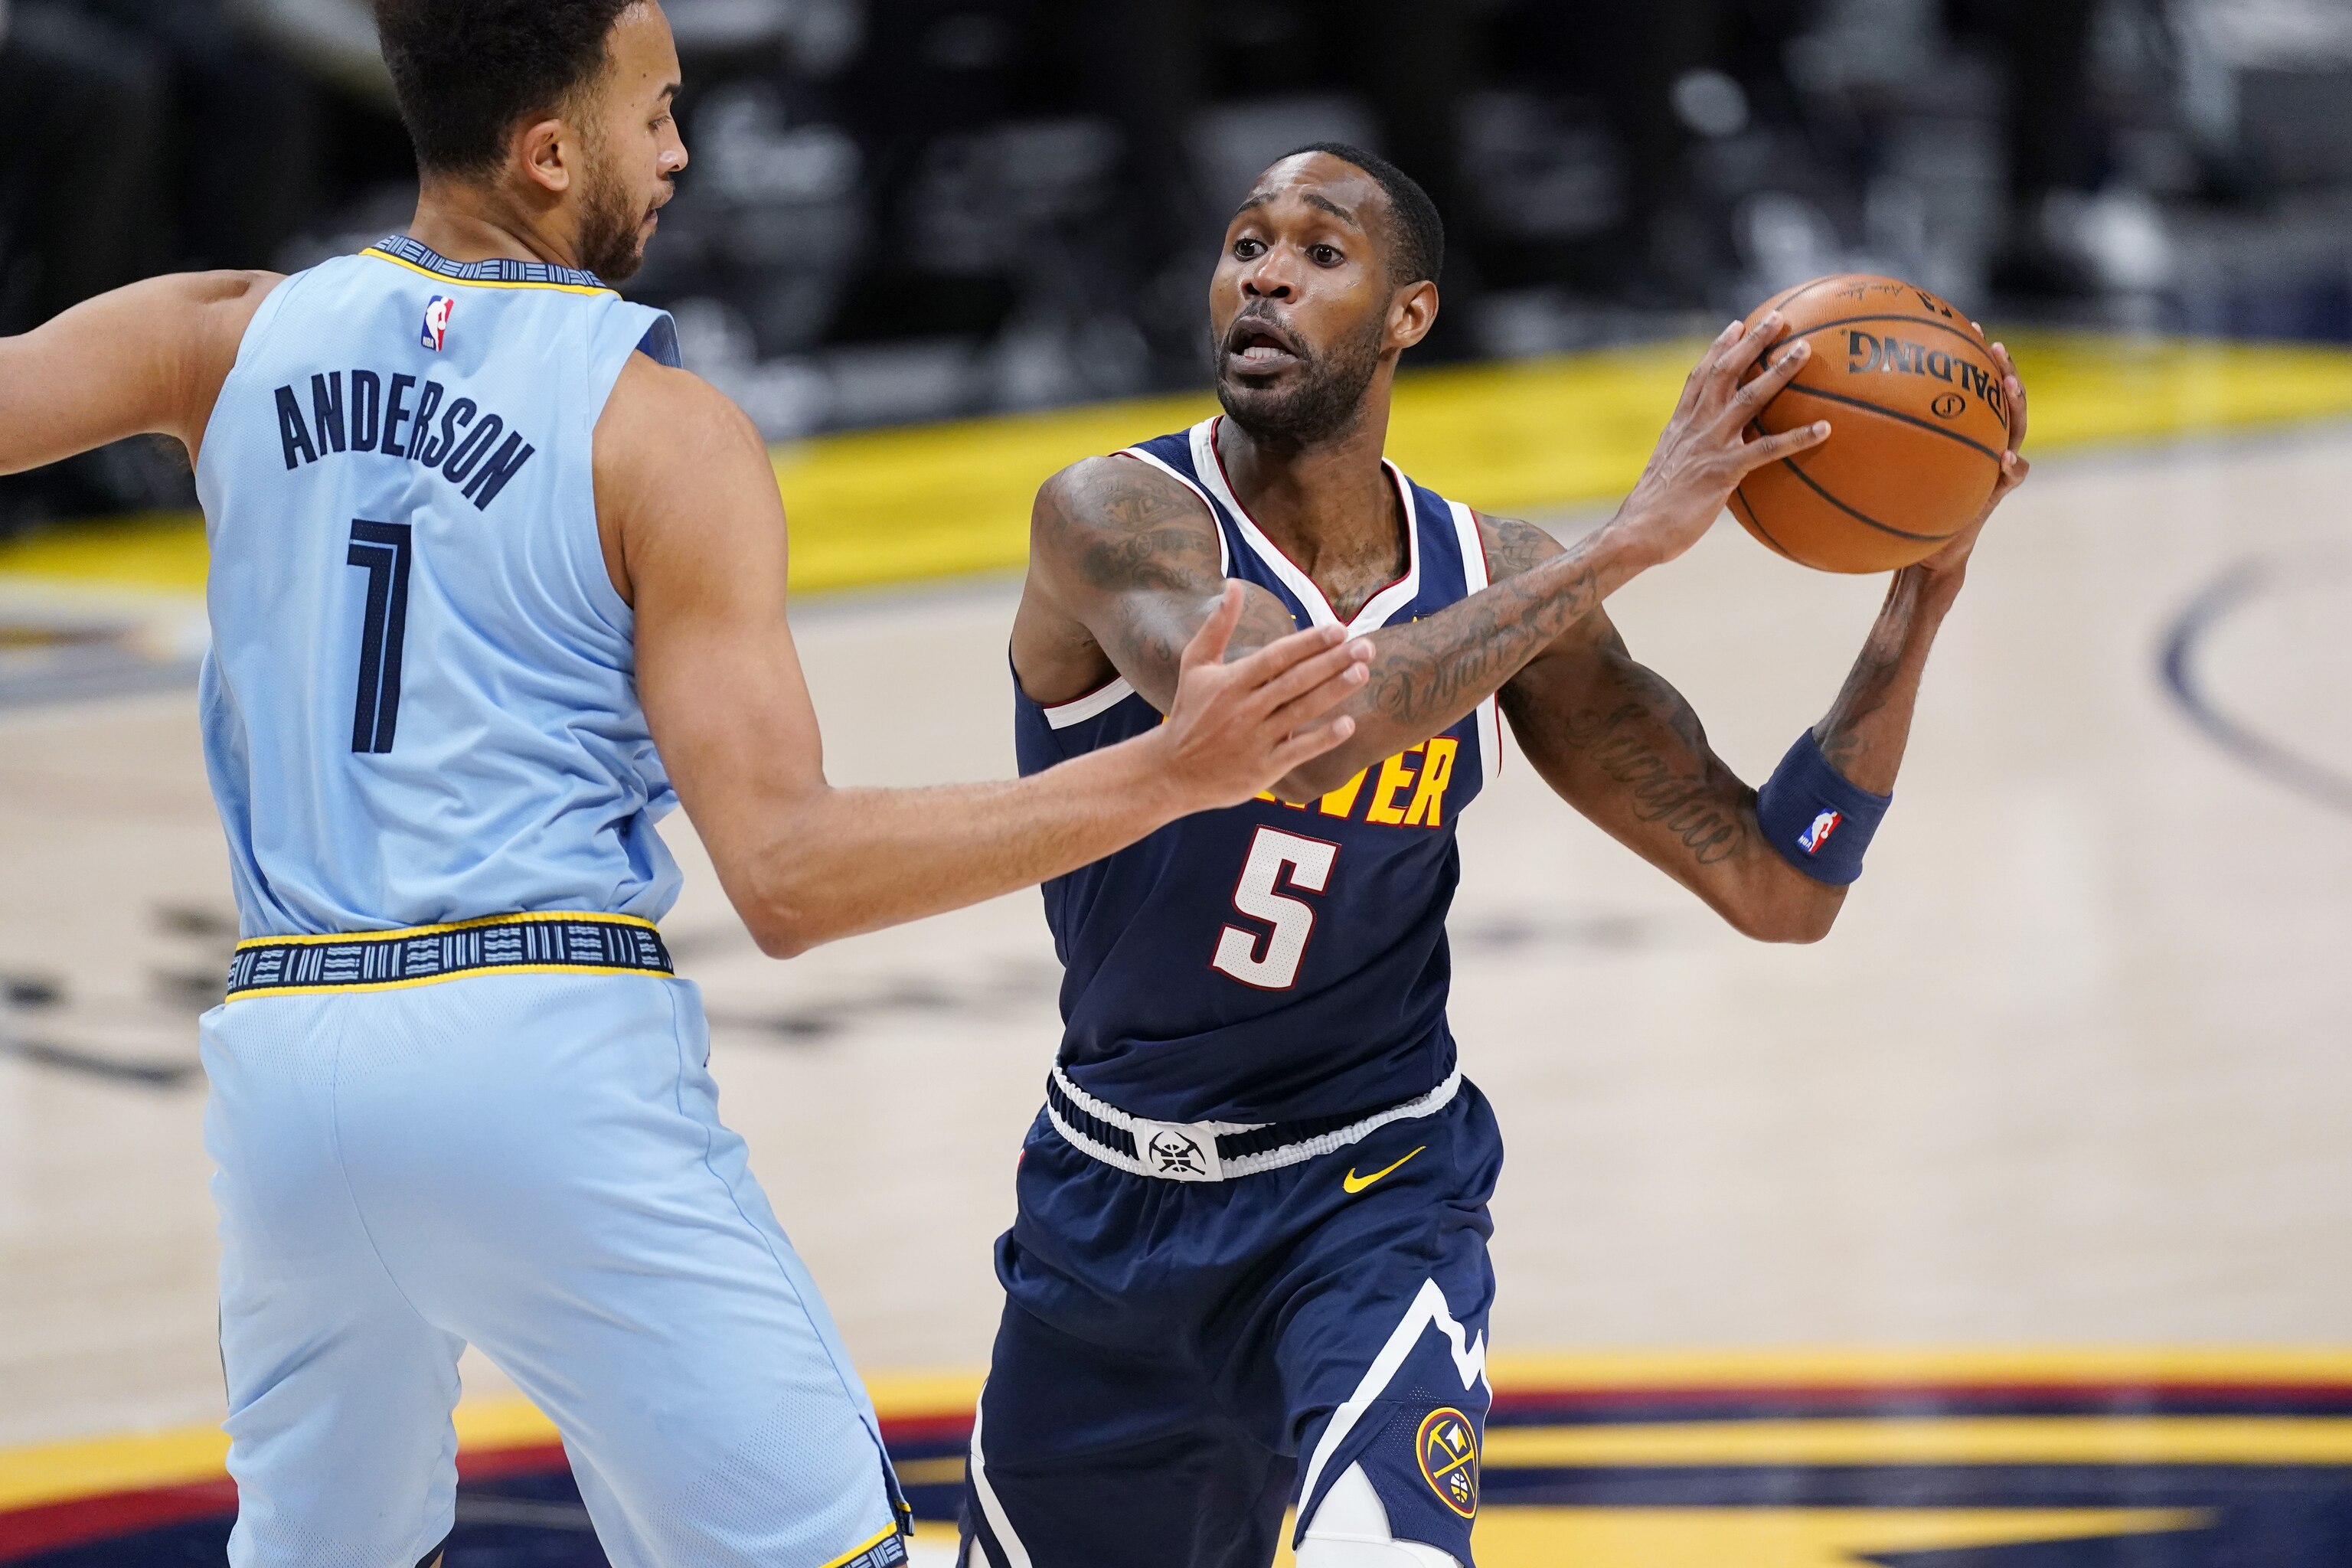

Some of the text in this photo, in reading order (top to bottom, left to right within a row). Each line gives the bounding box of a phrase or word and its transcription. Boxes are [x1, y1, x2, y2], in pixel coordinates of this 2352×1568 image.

[423, 336, 434, 349] NBA
[274, 369, 536, 511] ANDERSON
[347, 518, 412, 755] 1
[1207, 824, 1342, 991] 5
[1797, 835, 1813, 849] NBA
